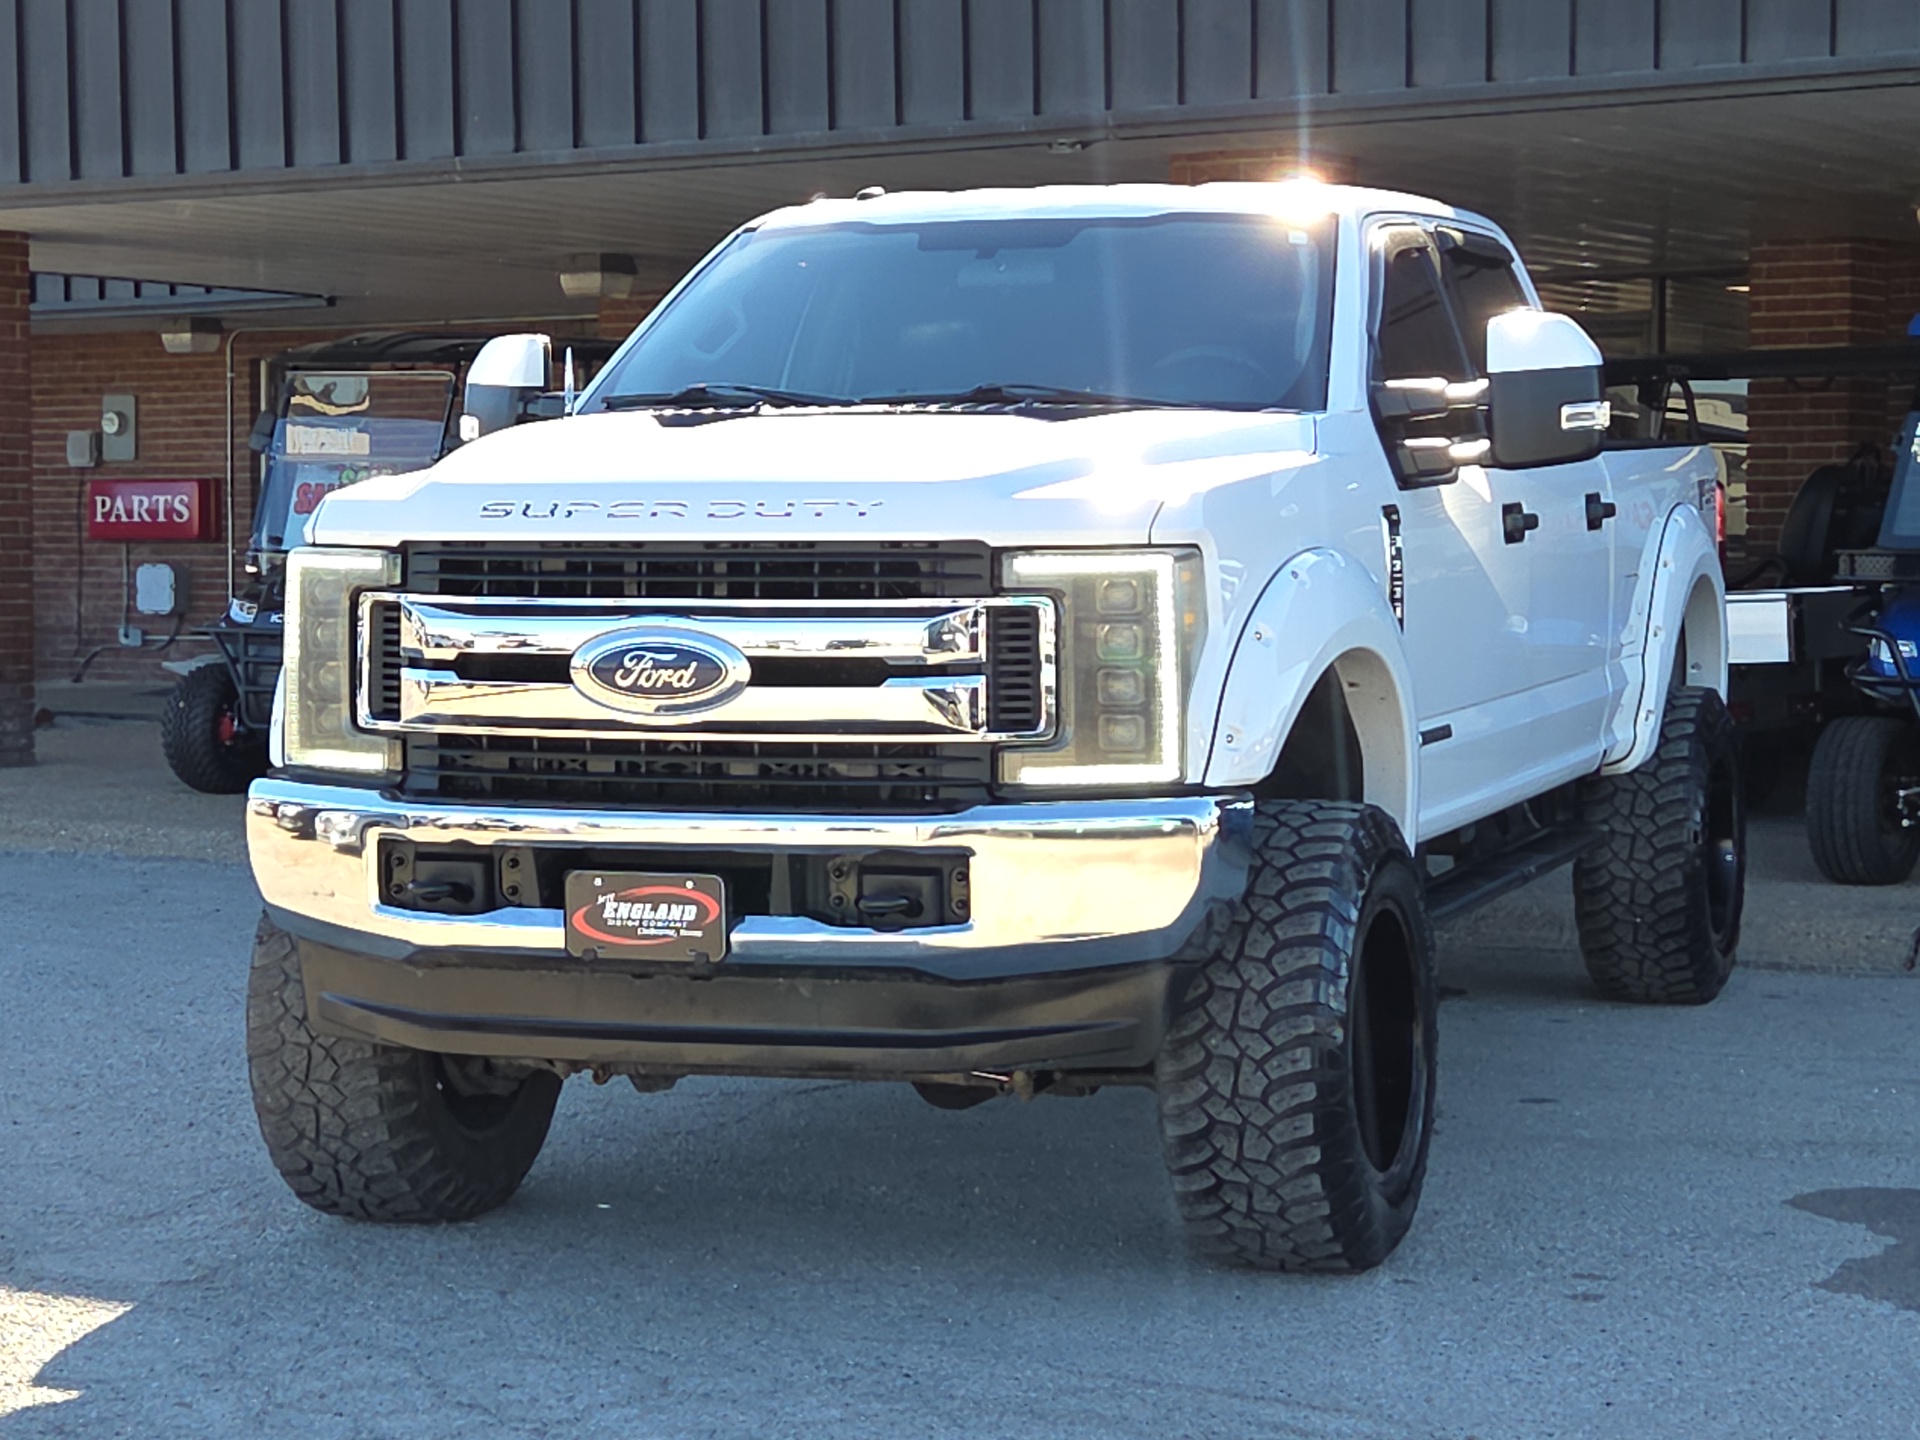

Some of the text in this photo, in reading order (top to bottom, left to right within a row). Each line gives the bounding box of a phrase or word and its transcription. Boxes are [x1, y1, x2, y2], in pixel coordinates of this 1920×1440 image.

[94, 494, 190, 523] PARTS
[480, 501, 883, 519] SUPER DUTY
[614, 650, 698, 688] Ford
[602, 901, 698, 922] ENGLAND
